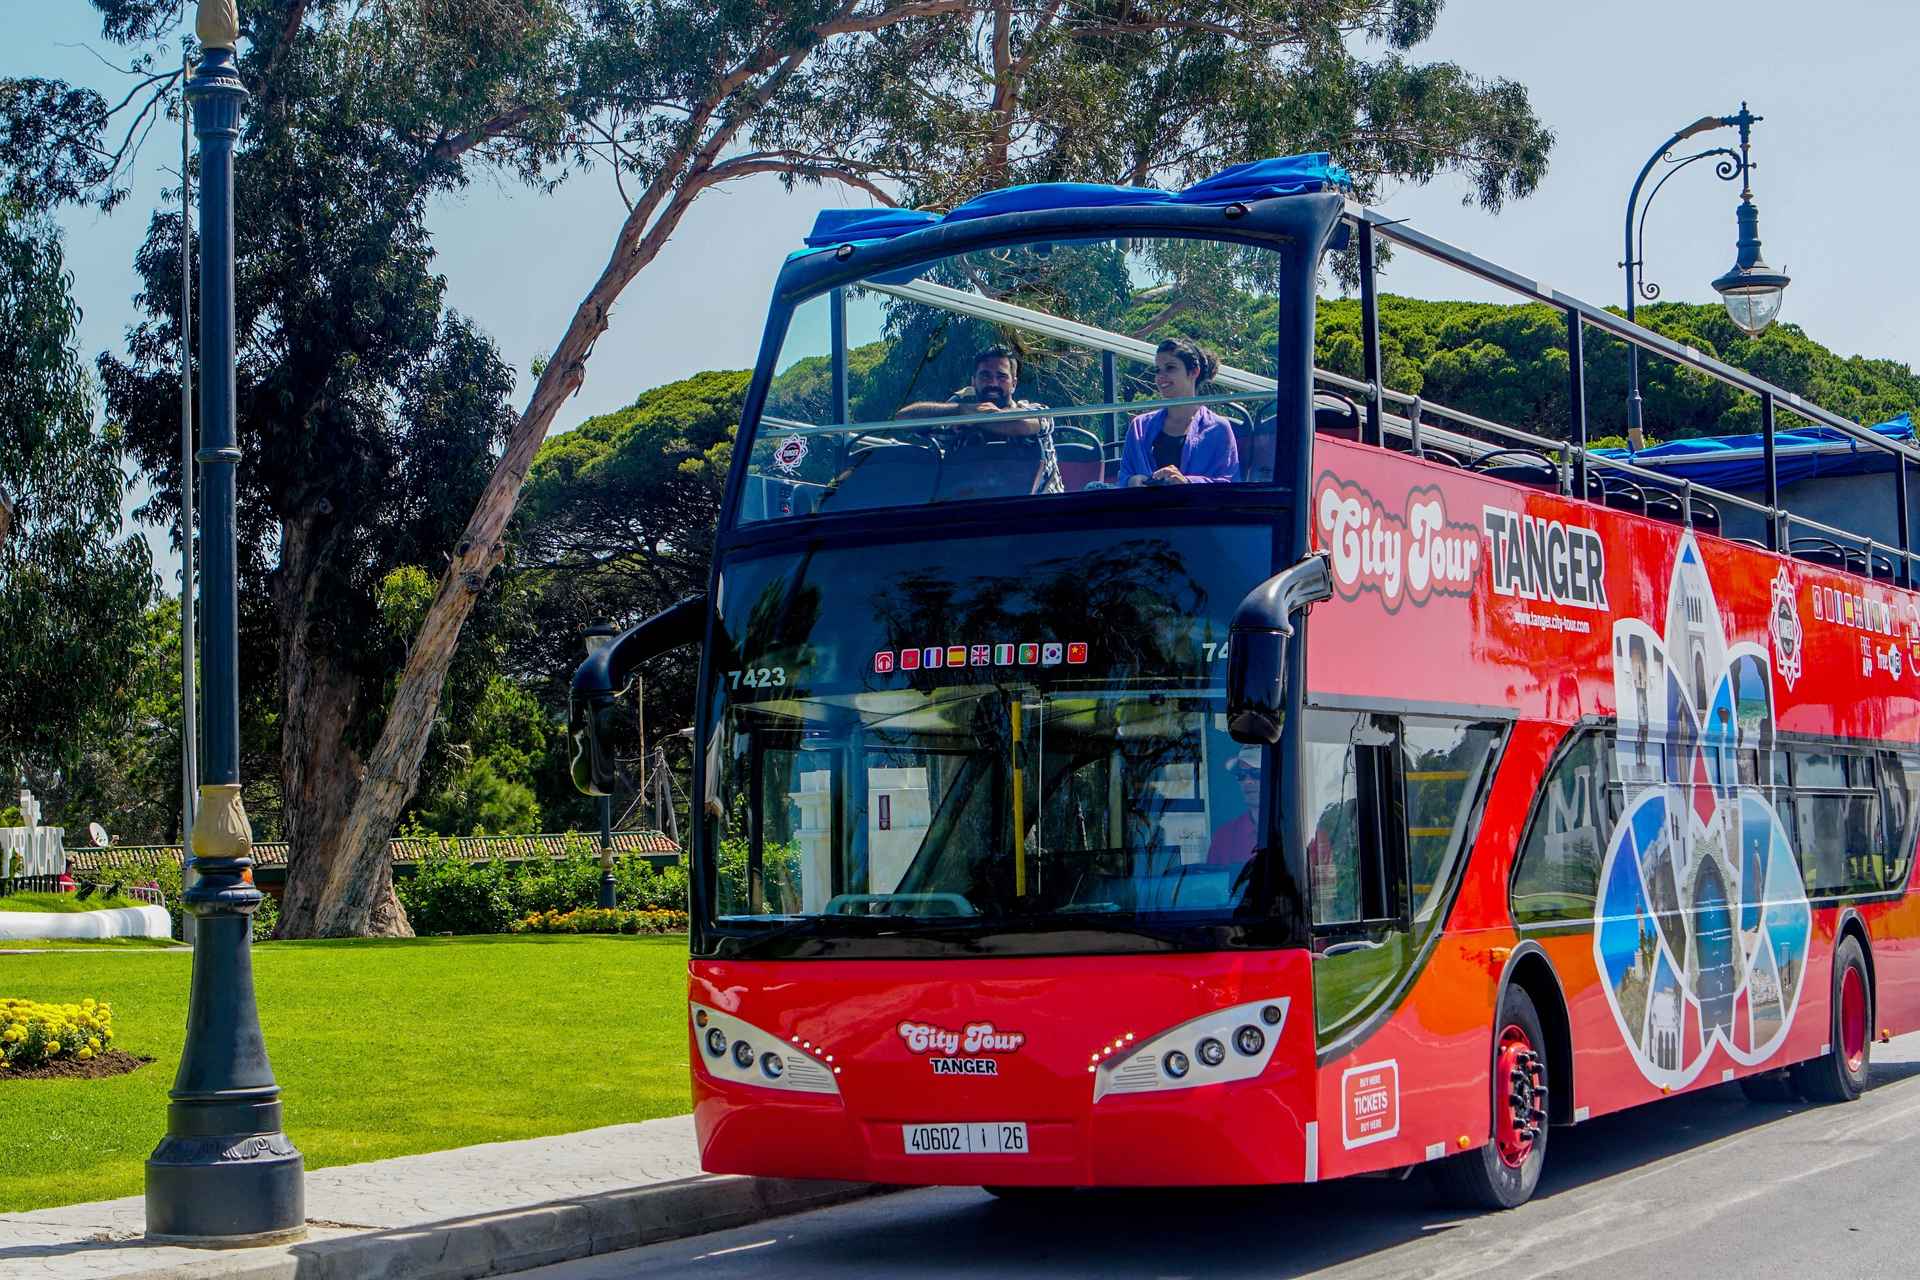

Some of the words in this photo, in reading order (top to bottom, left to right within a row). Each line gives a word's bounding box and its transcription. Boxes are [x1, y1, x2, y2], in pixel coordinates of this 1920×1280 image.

[1320, 488, 1401, 598] City
[1407, 501, 1478, 591] Tour
[1483, 505, 1609, 611] TANGER
[728, 667, 786, 690] 7423
[900, 1023, 960, 1054] City
[964, 1024, 1024, 1052] Tour
[930, 1058, 998, 1075] TANGER
[1353, 1091, 1388, 1116] TICKETS
[911, 1127, 961, 1151] 40602
[1003, 1126, 1023, 1150] 26
